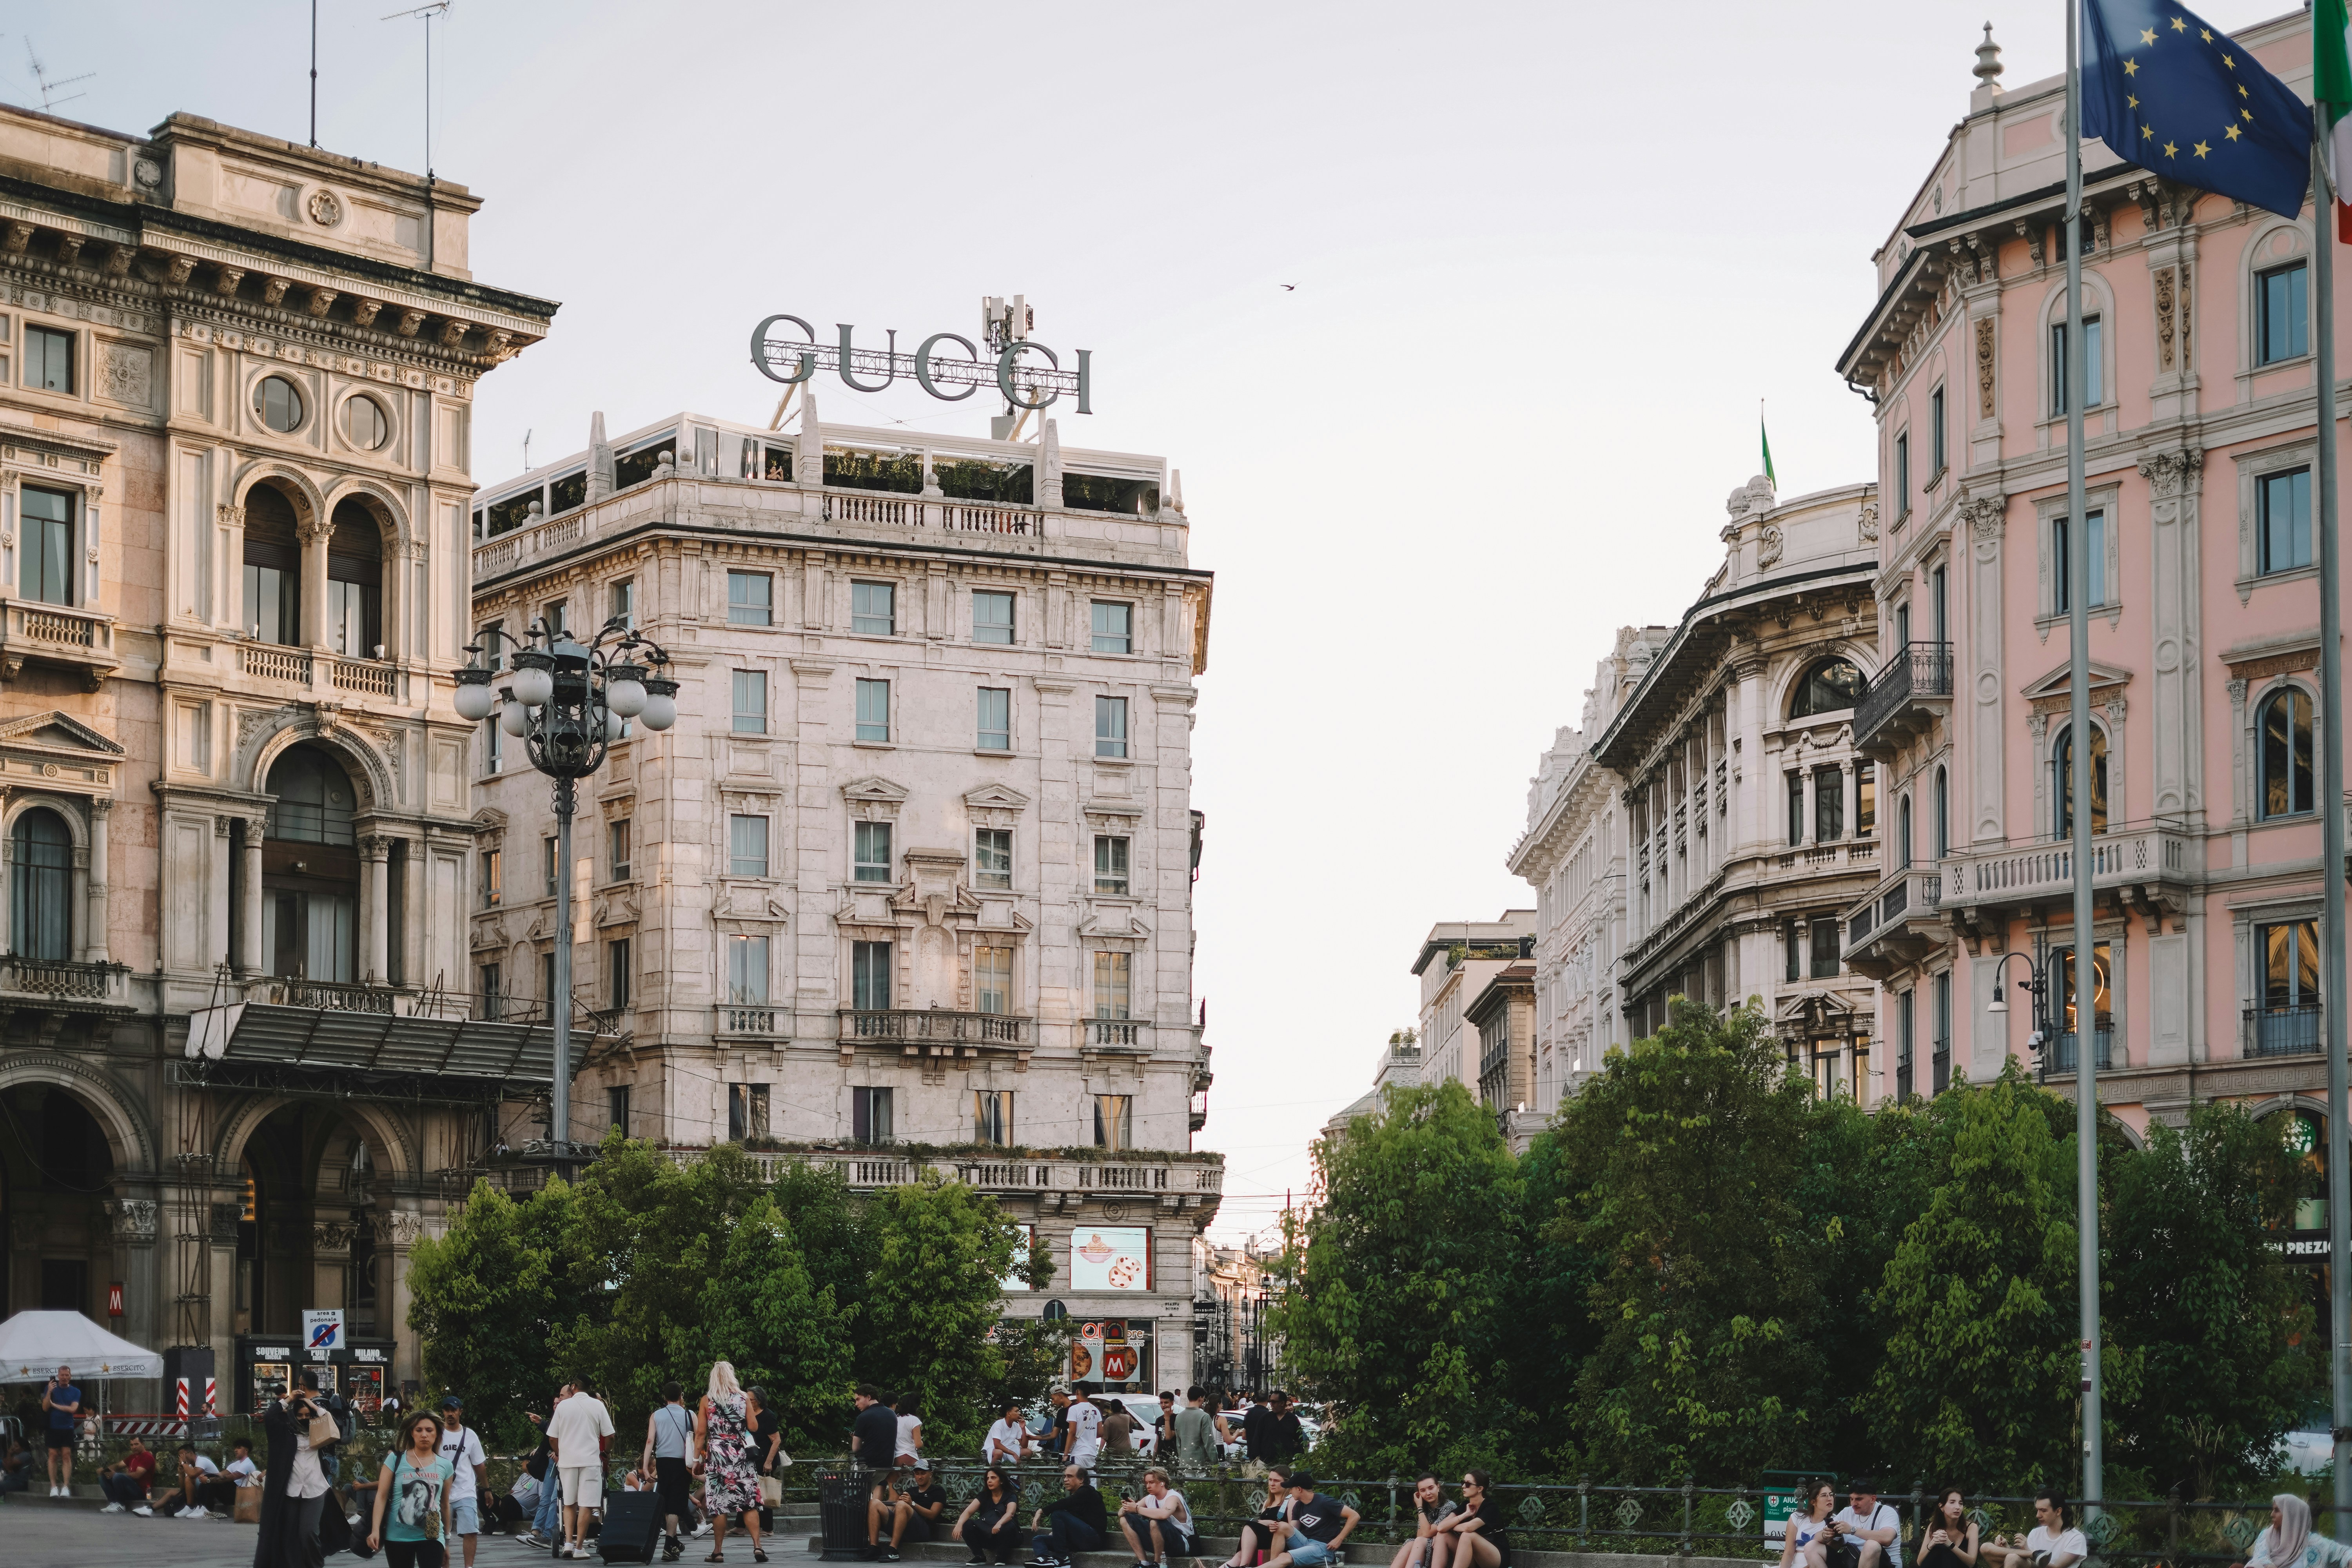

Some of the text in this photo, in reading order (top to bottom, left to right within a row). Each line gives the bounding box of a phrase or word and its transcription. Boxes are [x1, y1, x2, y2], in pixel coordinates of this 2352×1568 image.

[751, 314, 1093, 415] GUCCI
[2287, 1241, 2331, 1254] PREZI
[110, 1290, 122, 1310] M
[256, 1347, 290, 1356] SOUVENIR
[355, 1348, 380, 1357] MILANO
[1107, 1357, 1124, 1372] M
